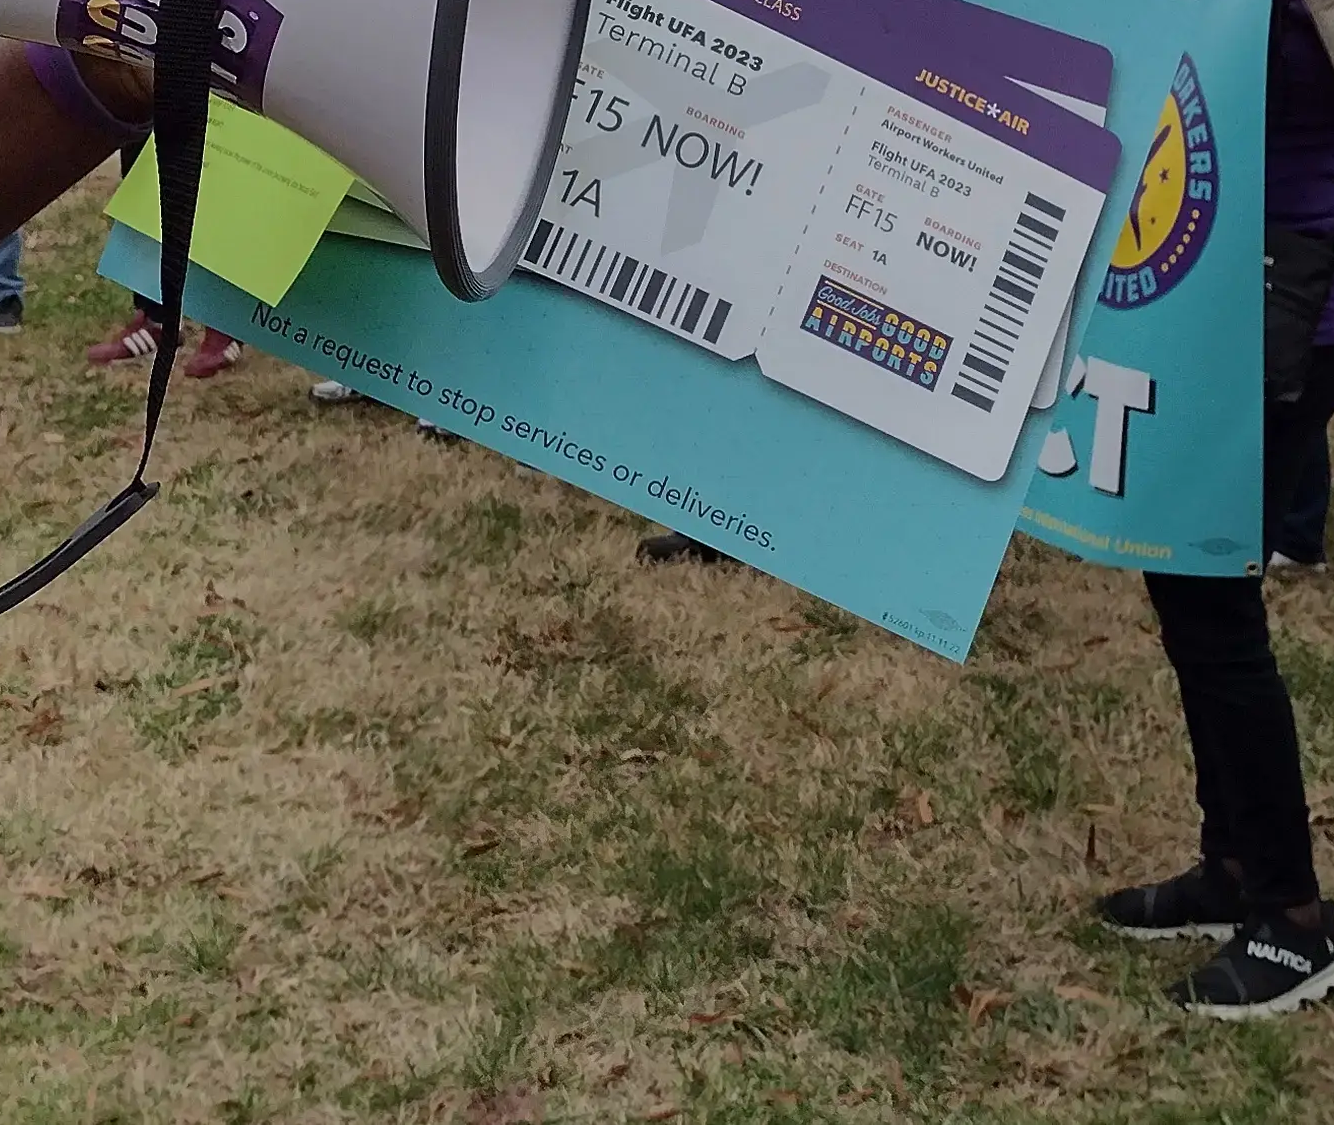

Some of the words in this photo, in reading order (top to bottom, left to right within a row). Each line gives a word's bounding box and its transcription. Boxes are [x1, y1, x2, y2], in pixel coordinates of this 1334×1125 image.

[596, 12, 720, 86] Terminal
[726, 72, 747, 97] B
[667, 16, 707, 47] UFA
[711, 38, 764, 72] 2023
[685, 106, 747, 140] BOARDING
[880, 118, 922, 144] Airport
[922, 138, 966, 167] Workers
[967, 160, 1004, 185] United
[887, 105, 953, 144] PASSENGER
[641, 114, 764, 196] NOW!
[867, 154, 926, 193] Terminal
[929, 186, 941, 198] B
[870, 140, 908, 166] Flight
[910, 159, 936, 181] UFA
[938, 173, 972, 198] 2023
[560, 169, 602, 218] 1A
[855, 183, 886, 204] GATE
[923, 216, 982, 251] BOARDING
[835, 233, 864, 252] SEAT
[872, 249, 887, 266] 1A
[845, 193, 898, 233] FF15
[915, 230, 978, 273] NOW!
[823, 258, 888, 296] DESTINATION
[805, 306, 937, 385] AIRPORTS
[817, 285, 852, 312] Good
[851, 304, 881, 327] Jobs
[881, 312, 947, 361] GOOD
[250, 302, 291, 338] Not
[293, 326, 308, 345] a
[312, 333, 404, 385] request
[407, 370, 433, 396] to
[438, 388, 495, 426] stop
[501, 415, 608, 472] services
[612, 464, 644, 487] or
[647, 475, 776, 552] deliveries.
[1115, 537, 1173, 559] Union
[1247, 940, 1313, 975] NAUTICA
